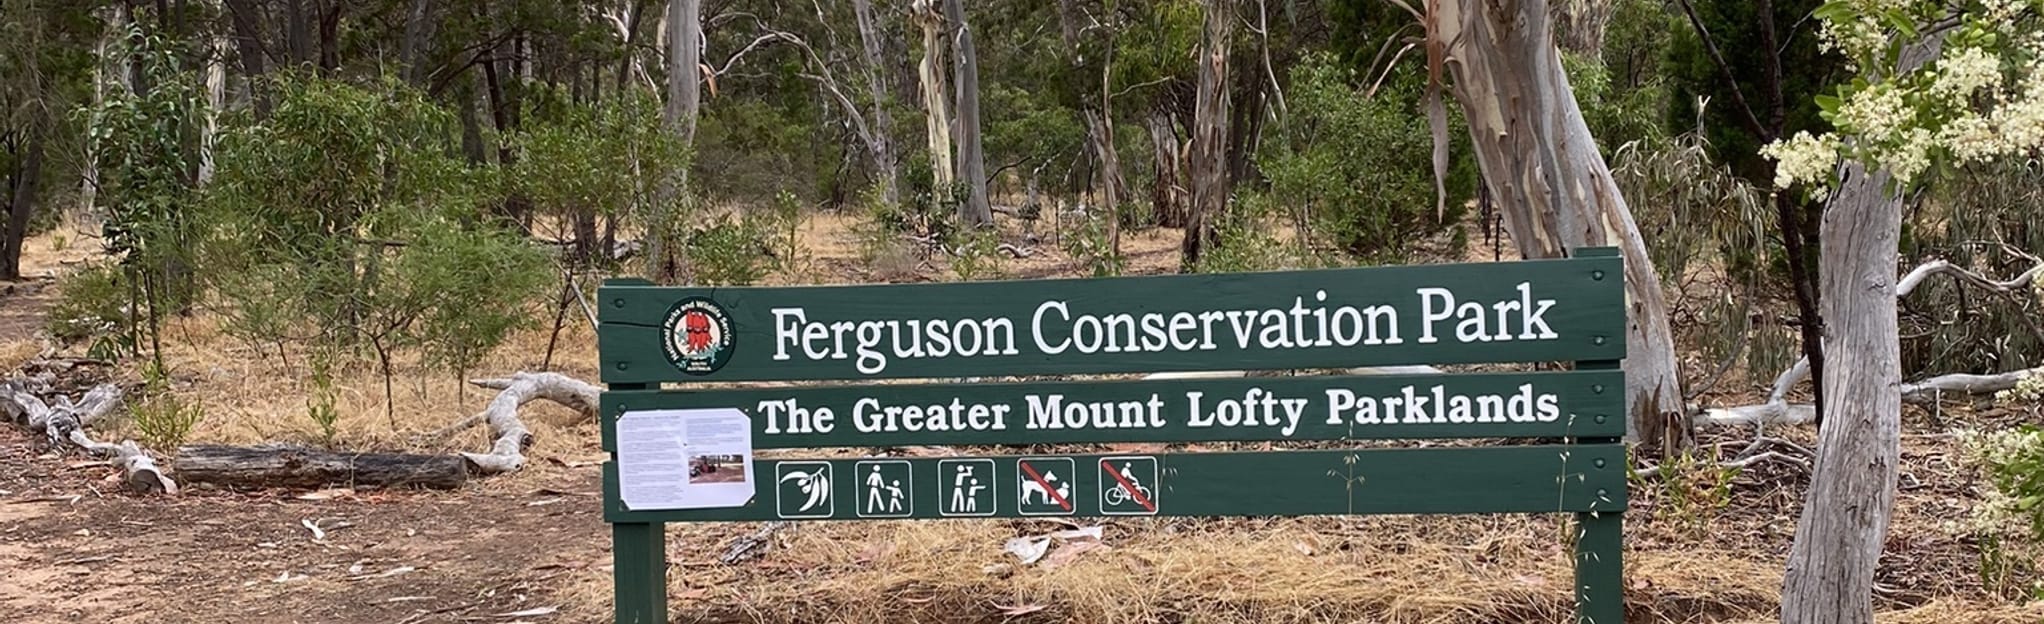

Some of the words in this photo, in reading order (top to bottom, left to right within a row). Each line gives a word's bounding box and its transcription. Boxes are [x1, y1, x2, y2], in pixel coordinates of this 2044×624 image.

[664, 309, 681, 329] Parks
[680, 300, 695, 311] and
[720, 316, 732, 346] Service
[771, 307, 1019, 375] Ferguson
[1031, 289, 1404, 355] Conservation
[1416, 282, 1558, 344] Park
[663, 328, 680, 361] National
[757, 398, 835, 435] The
[852, 397, 1011, 433] Greater
[1024, 393, 1166, 430] Mount
[1186, 387, 1308, 437] Lofty
[1325, 383, 1560, 425] Parklands
